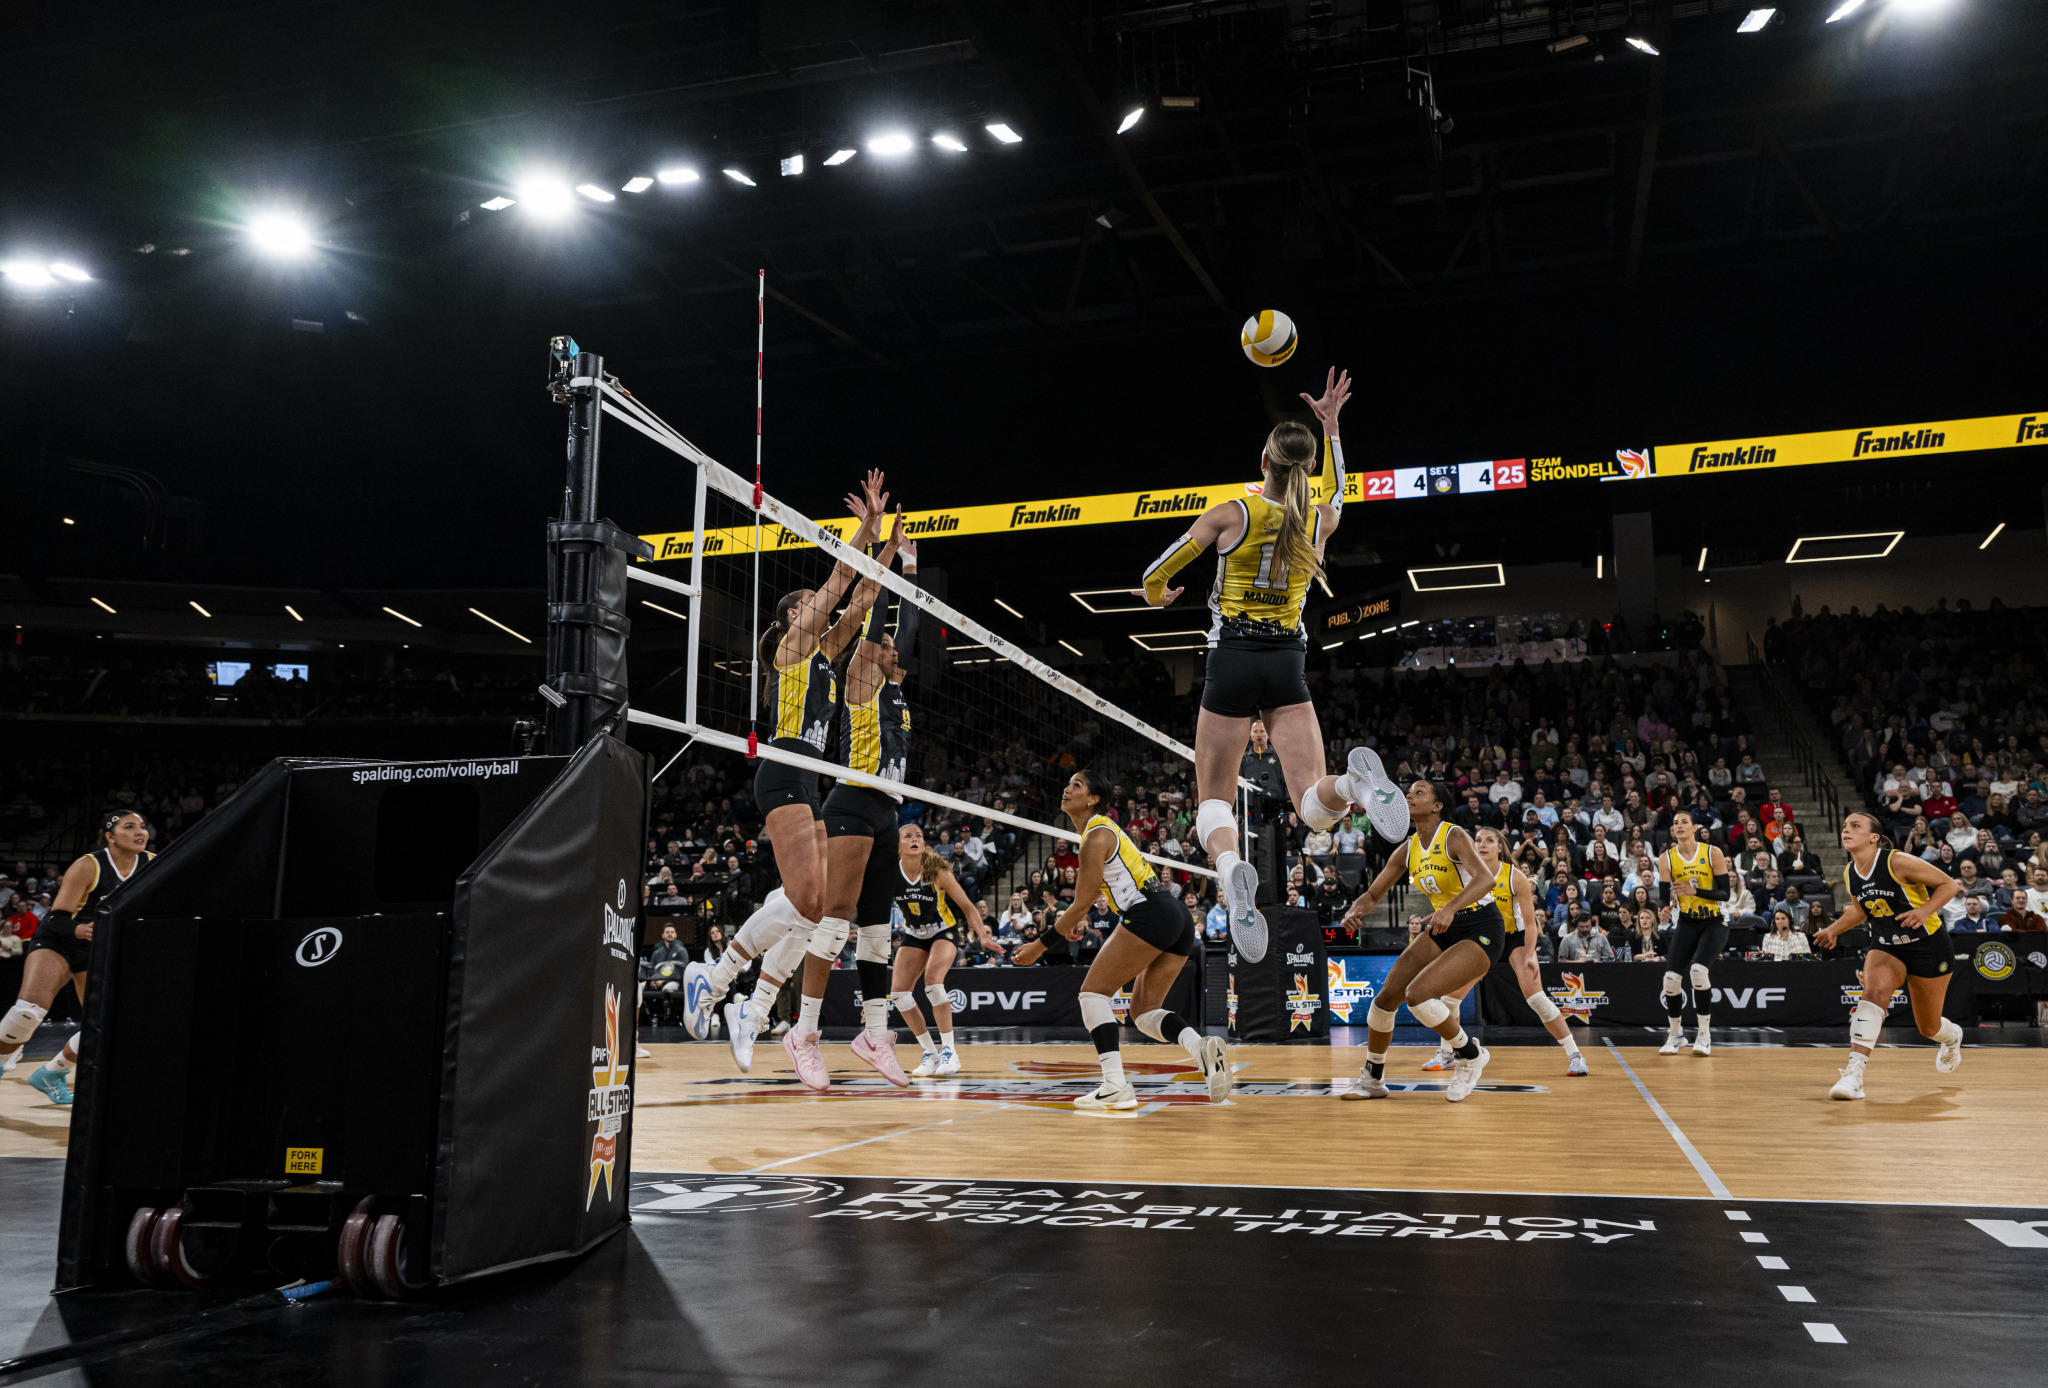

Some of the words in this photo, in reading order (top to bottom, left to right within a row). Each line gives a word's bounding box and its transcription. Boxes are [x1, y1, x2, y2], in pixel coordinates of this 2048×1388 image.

[1430, 467, 1448, 475] SET
[1450, 465, 1457, 475] 2
[1531, 462, 1618, 481] SHONDELL
[1532, 457, 1561, 468] TEAM
[1414, 475, 1426, 490] 4
[1479, 469, 1491, 484] 4
[1497, 465, 1524, 484] 25
[1368, 477, 1394, 495] 22
[1243, 590, 1291, 605] MADDUX
[1328, 613, 1350, 628] FUEL
[1362, 600, 1390, 618] ZONE
[352, 760, 519, 784] spalding.com/volleyball
[1286, 952, 1314, 965] SPALDING
[971, 991, 1047, 1010] PVF
[291, 1151, 317, 1160] FORK
[290, 1162, 316, 1171] HERE
[893, 1181, 1144, 1199] TEAM
[840, 1193, 1657, 1231] REHABILITATION
[809, 1209, 1196, 1230] PHYSICAL
[1233, 1221, 1635, 1244] THERAPY
